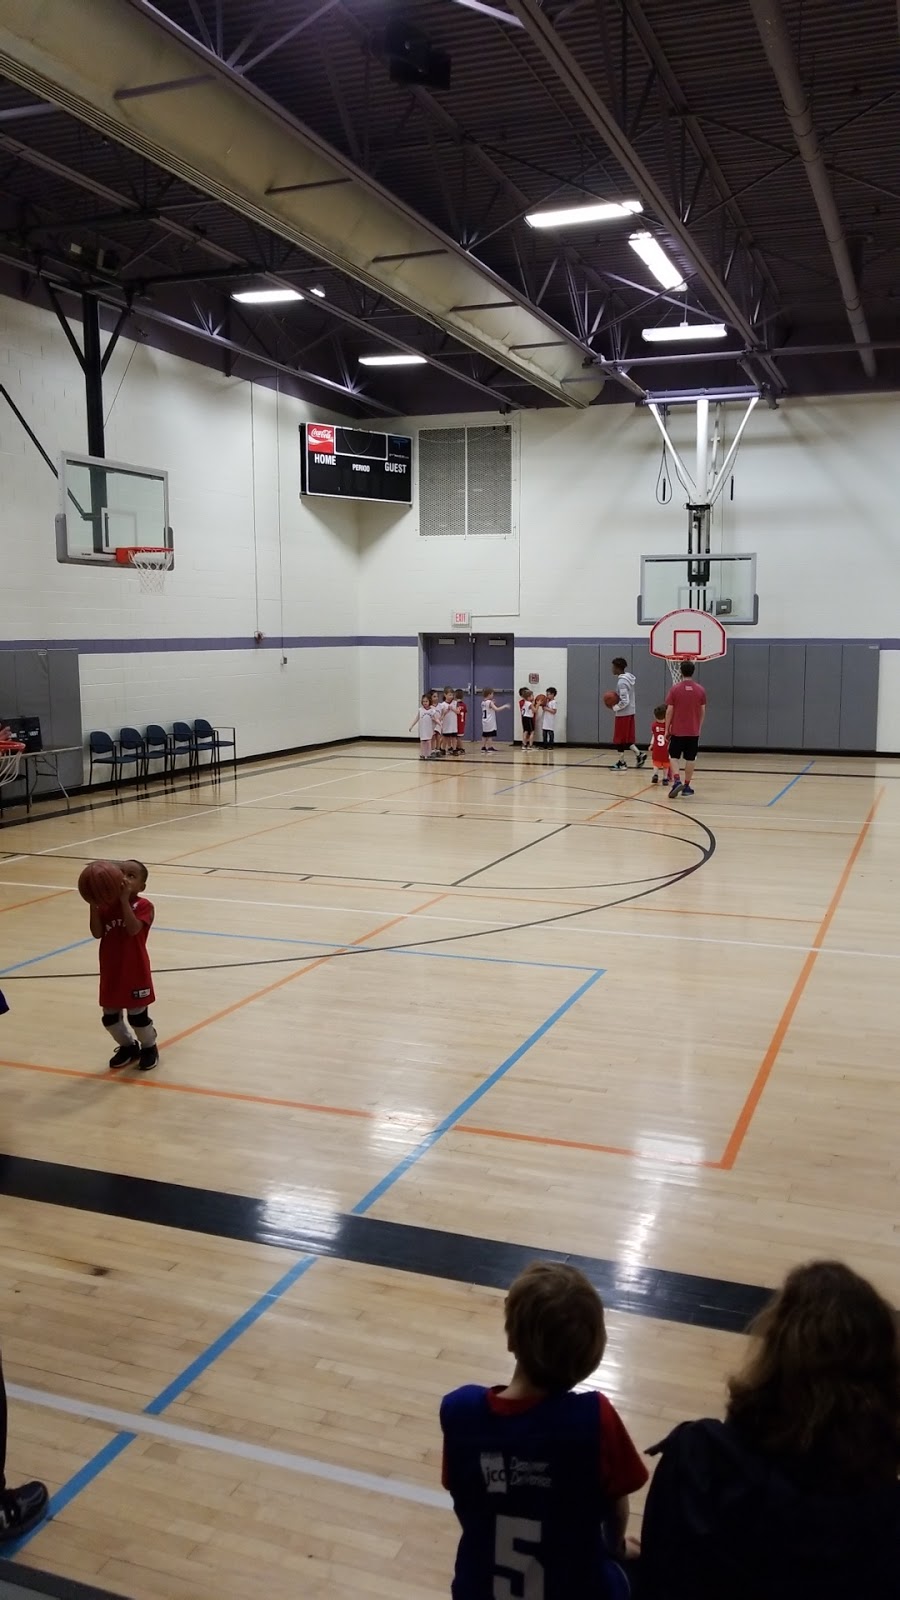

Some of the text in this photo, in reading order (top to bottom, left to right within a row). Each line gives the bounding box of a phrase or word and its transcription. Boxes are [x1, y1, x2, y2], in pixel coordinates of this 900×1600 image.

[314, 453, 337, 466] HOME
[352, 463, 370, 473] PERIOD
[384, 461, 407, 474] GUEST
[455, 612, 466, 623] EXIT
[656, 734, 666, 747] 9
[493, 1514, 545, 1600] 5
